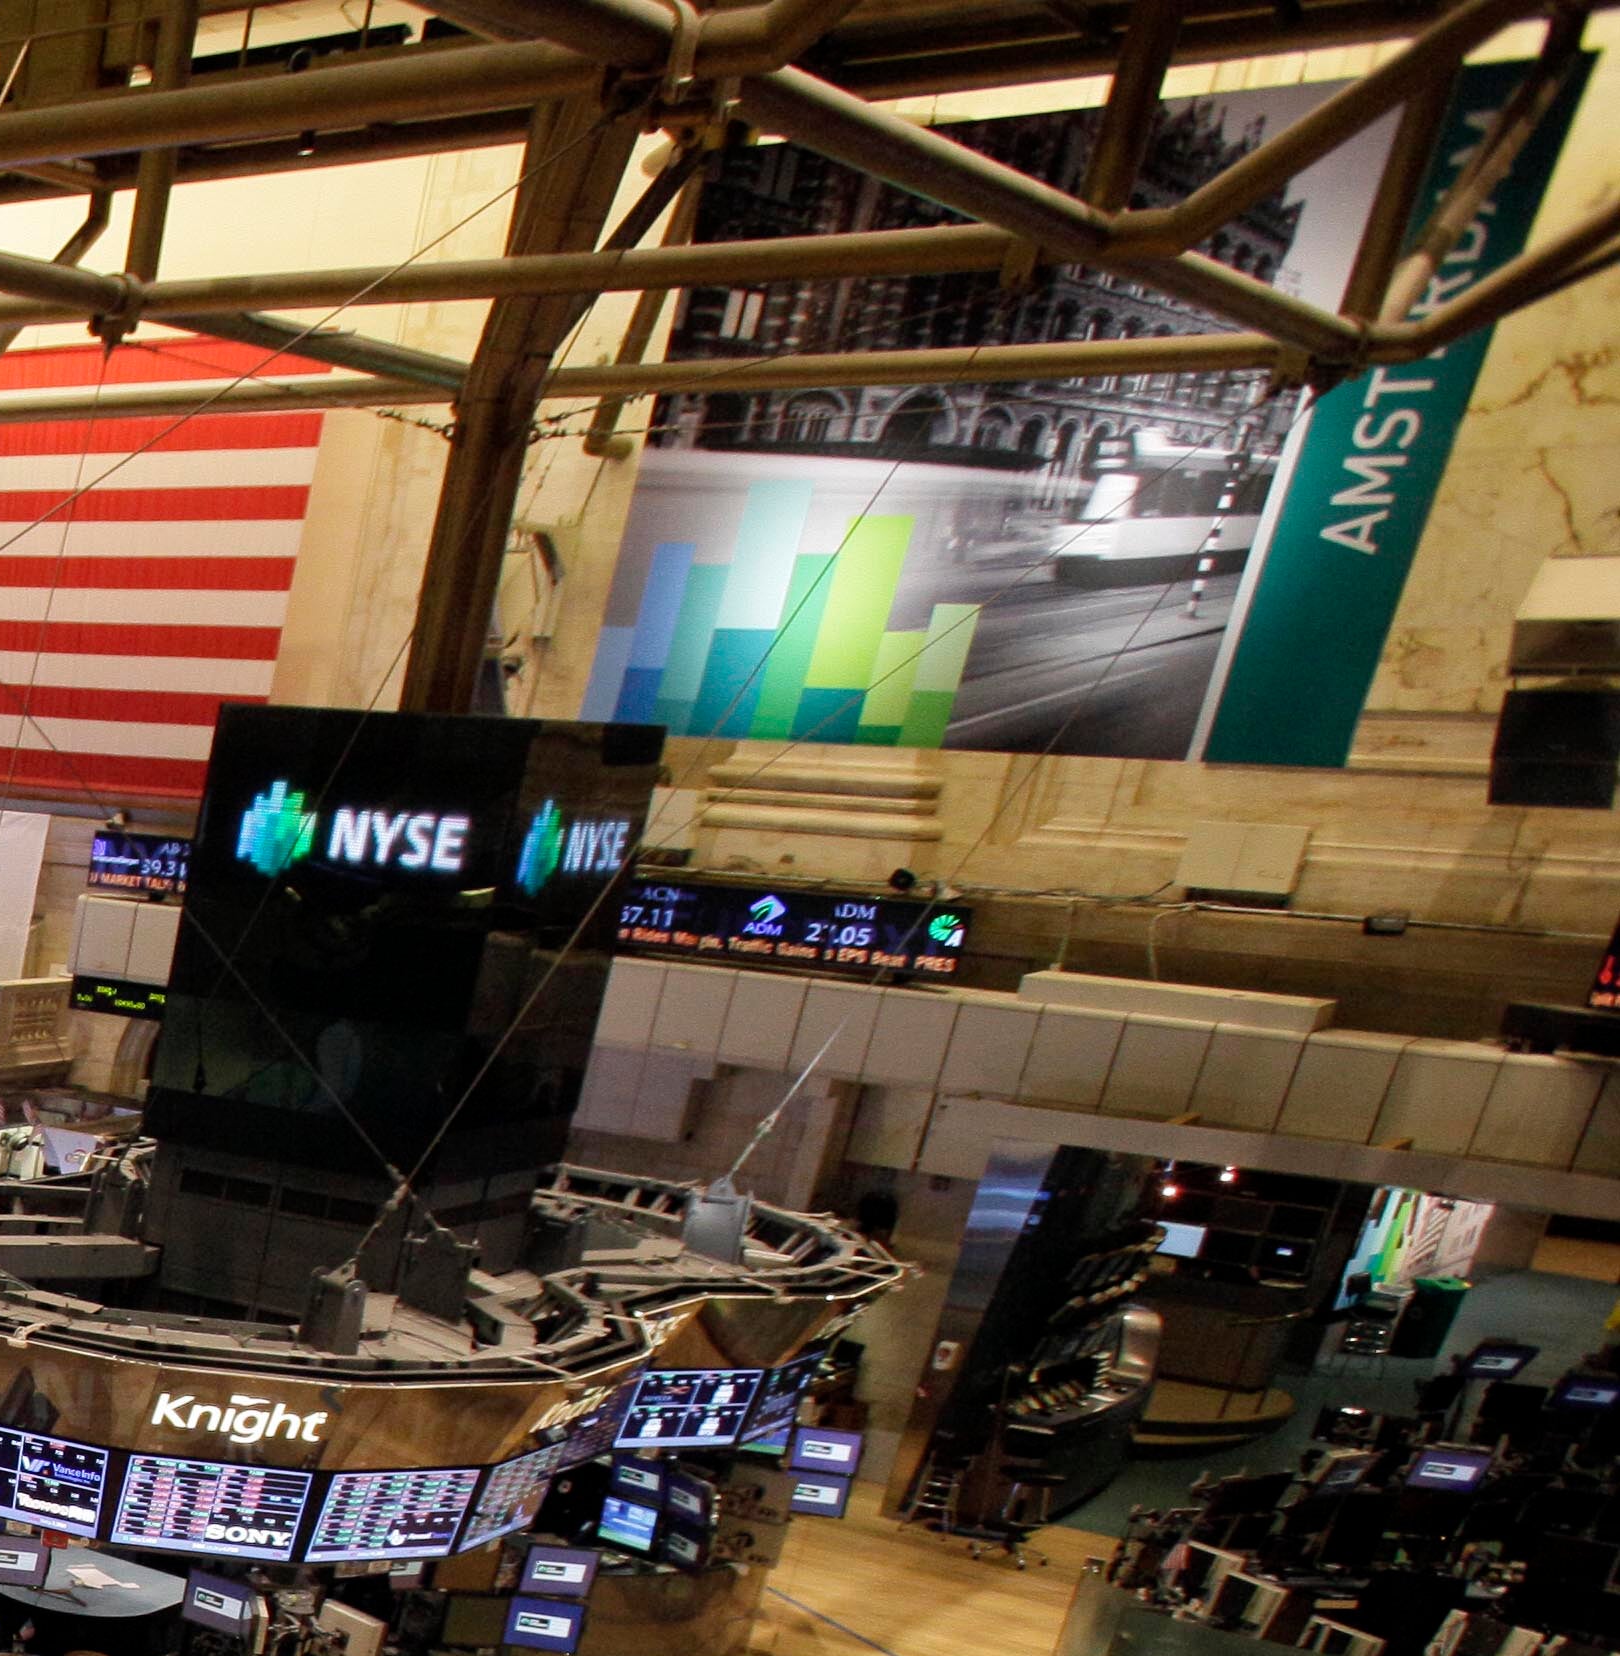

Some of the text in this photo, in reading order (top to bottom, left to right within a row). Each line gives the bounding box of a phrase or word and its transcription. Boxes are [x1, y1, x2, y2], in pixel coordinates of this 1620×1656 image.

[327, 807, 471, 871] NYSE
[563, 820, 630, 873] NYSE
[101, 872, 142, 888] MARKET
[641, 887, 680, 901] ACN
[743, 921, 783, 936] ADM
[804, 922, 873, 946] 2.05
[837, 947, 868, 964] EPS
[914, 955, 958, 972] PRES
[151, 1392, 328, 1444] Knight
[52, 1462, 101, 1481] VanceInfo
